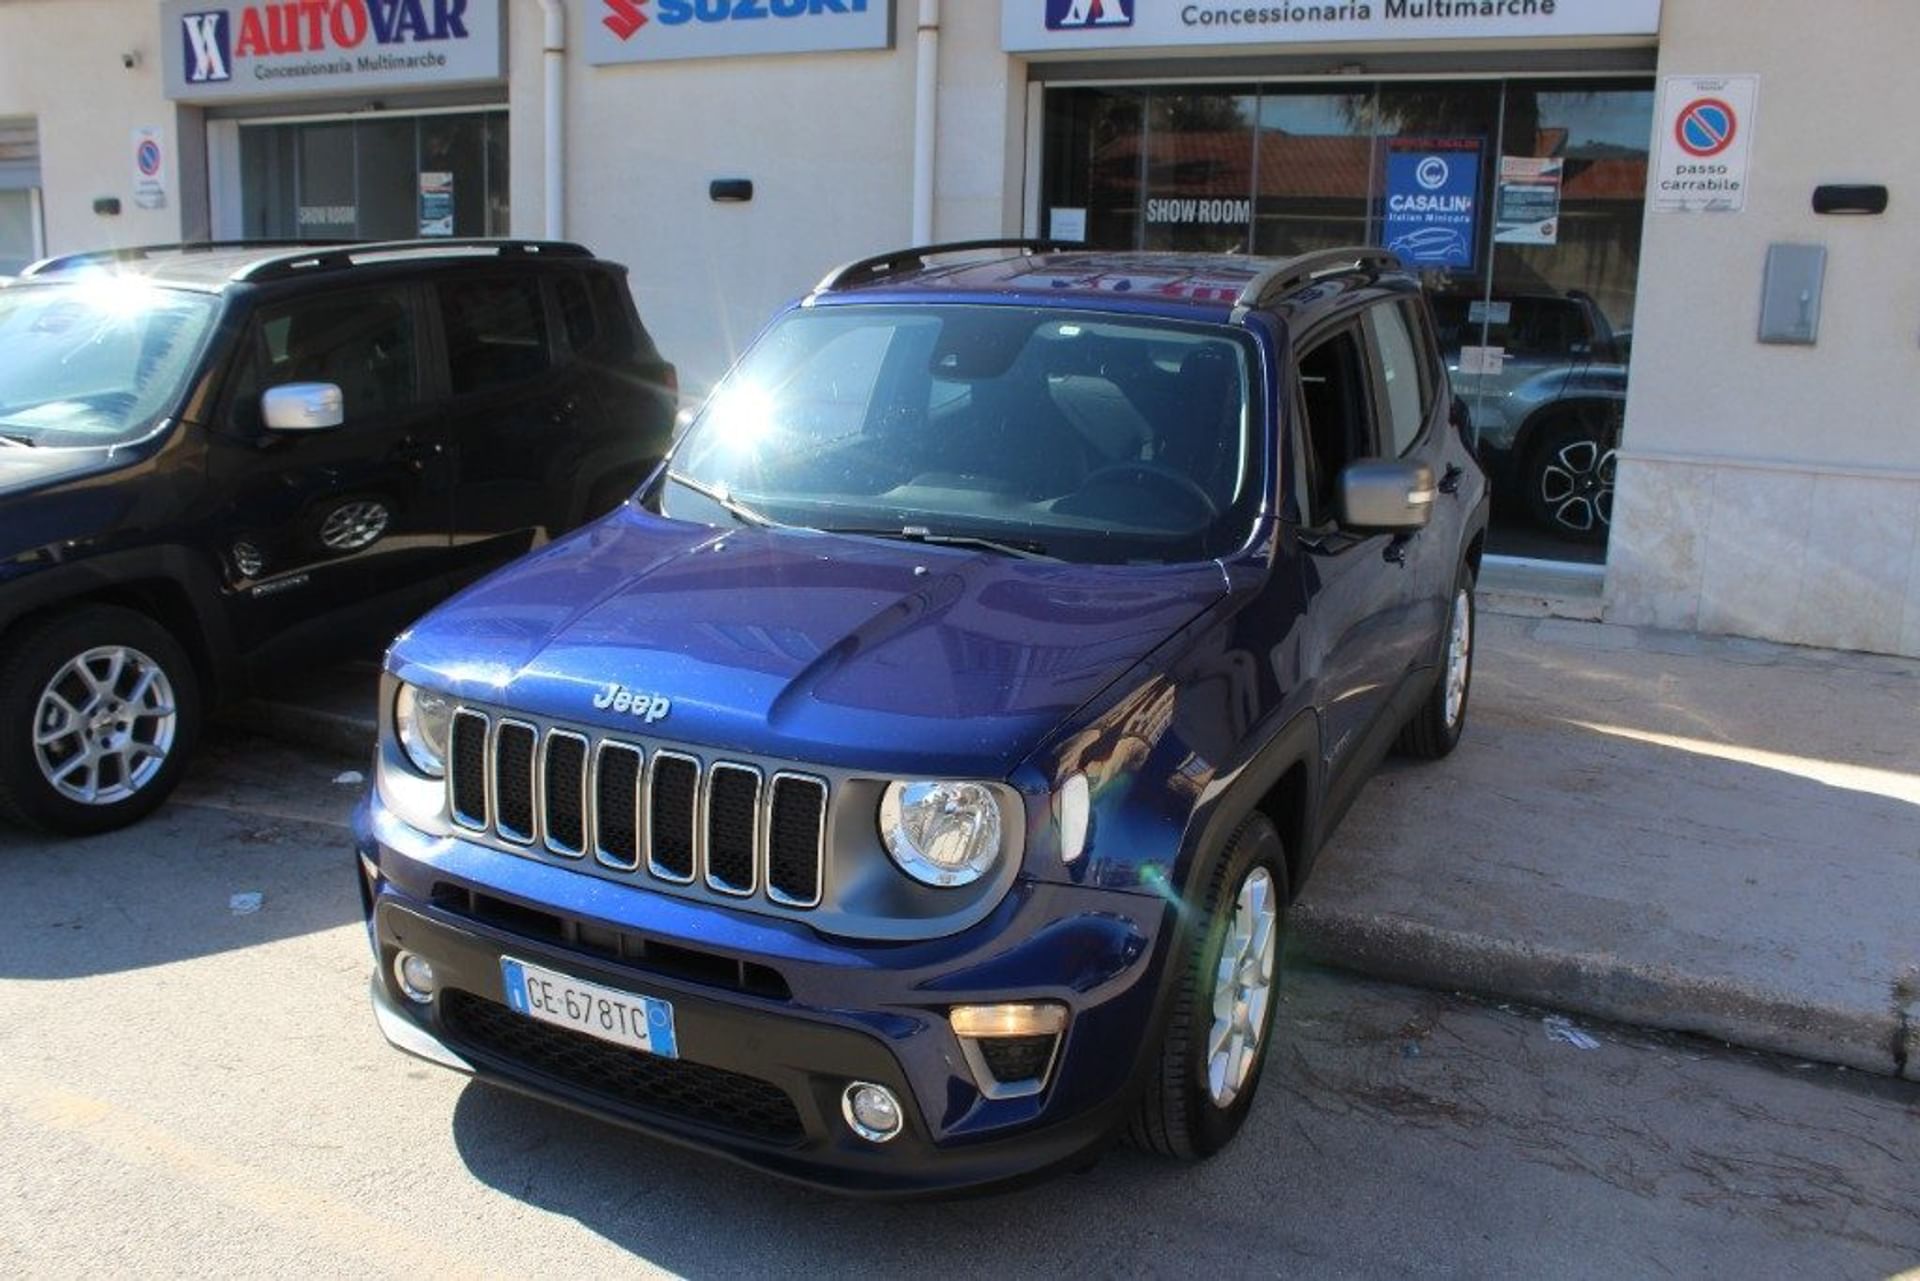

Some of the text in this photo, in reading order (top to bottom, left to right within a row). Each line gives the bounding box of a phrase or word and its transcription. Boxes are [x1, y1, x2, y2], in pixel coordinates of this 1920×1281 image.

[657, 0, 867, 25] SUZ
[1181, 0, 1556, 26] Concessionaria Multimarche
[234, 0, 469, 57] AUTOVAR
[254, 51, 447, 80] Concessionaria Multimarche
[1675, 164, 1728, 175] passo
[1660, 178, 1740, 191] carrabile
[1147, 198, 1250, 223] SHOW ROOM
[593, 682, 671, 723] Jeep
